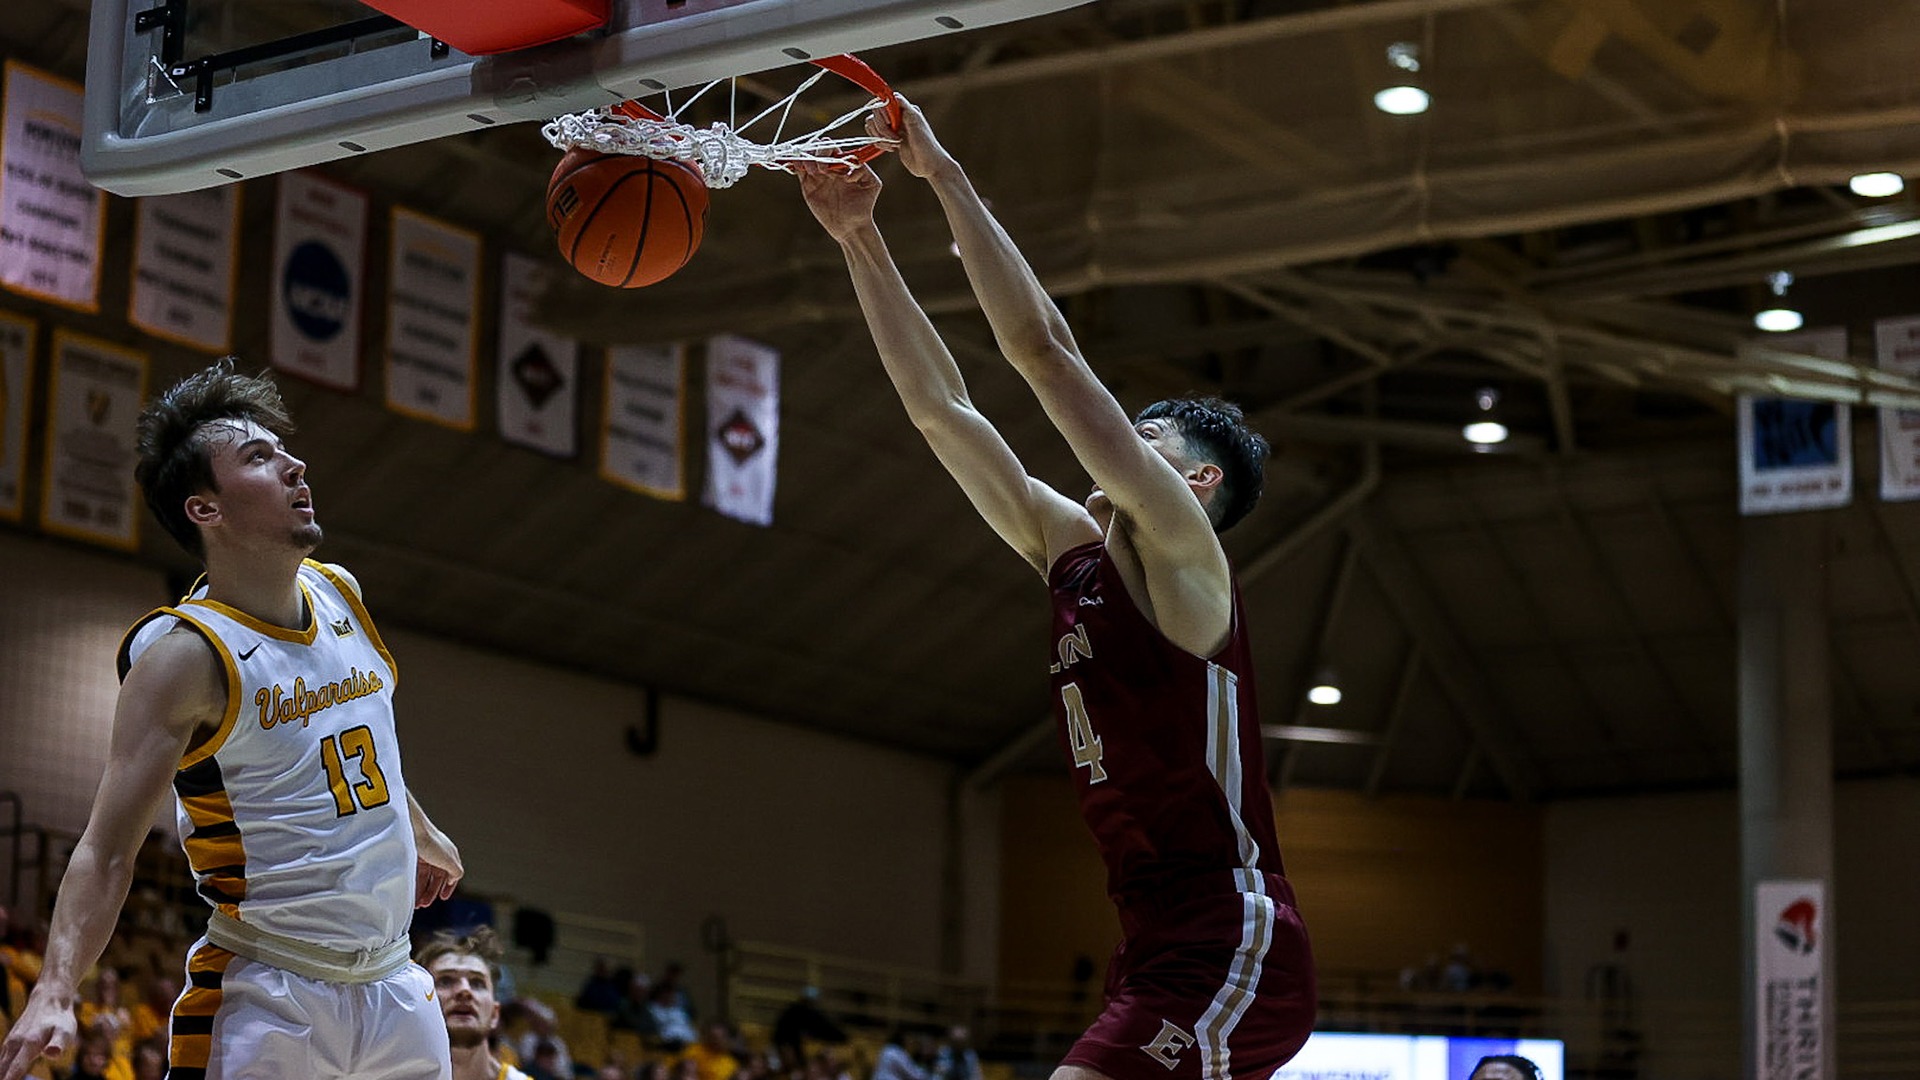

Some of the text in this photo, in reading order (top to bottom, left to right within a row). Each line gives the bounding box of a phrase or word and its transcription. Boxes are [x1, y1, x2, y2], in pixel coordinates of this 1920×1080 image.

[254, 667, 384, 730] Valparaiso
[1061, 682, 1108, 785] 4
[319, 724, 391, 818] 13
[1139, 1018, 1196, 1071] E
